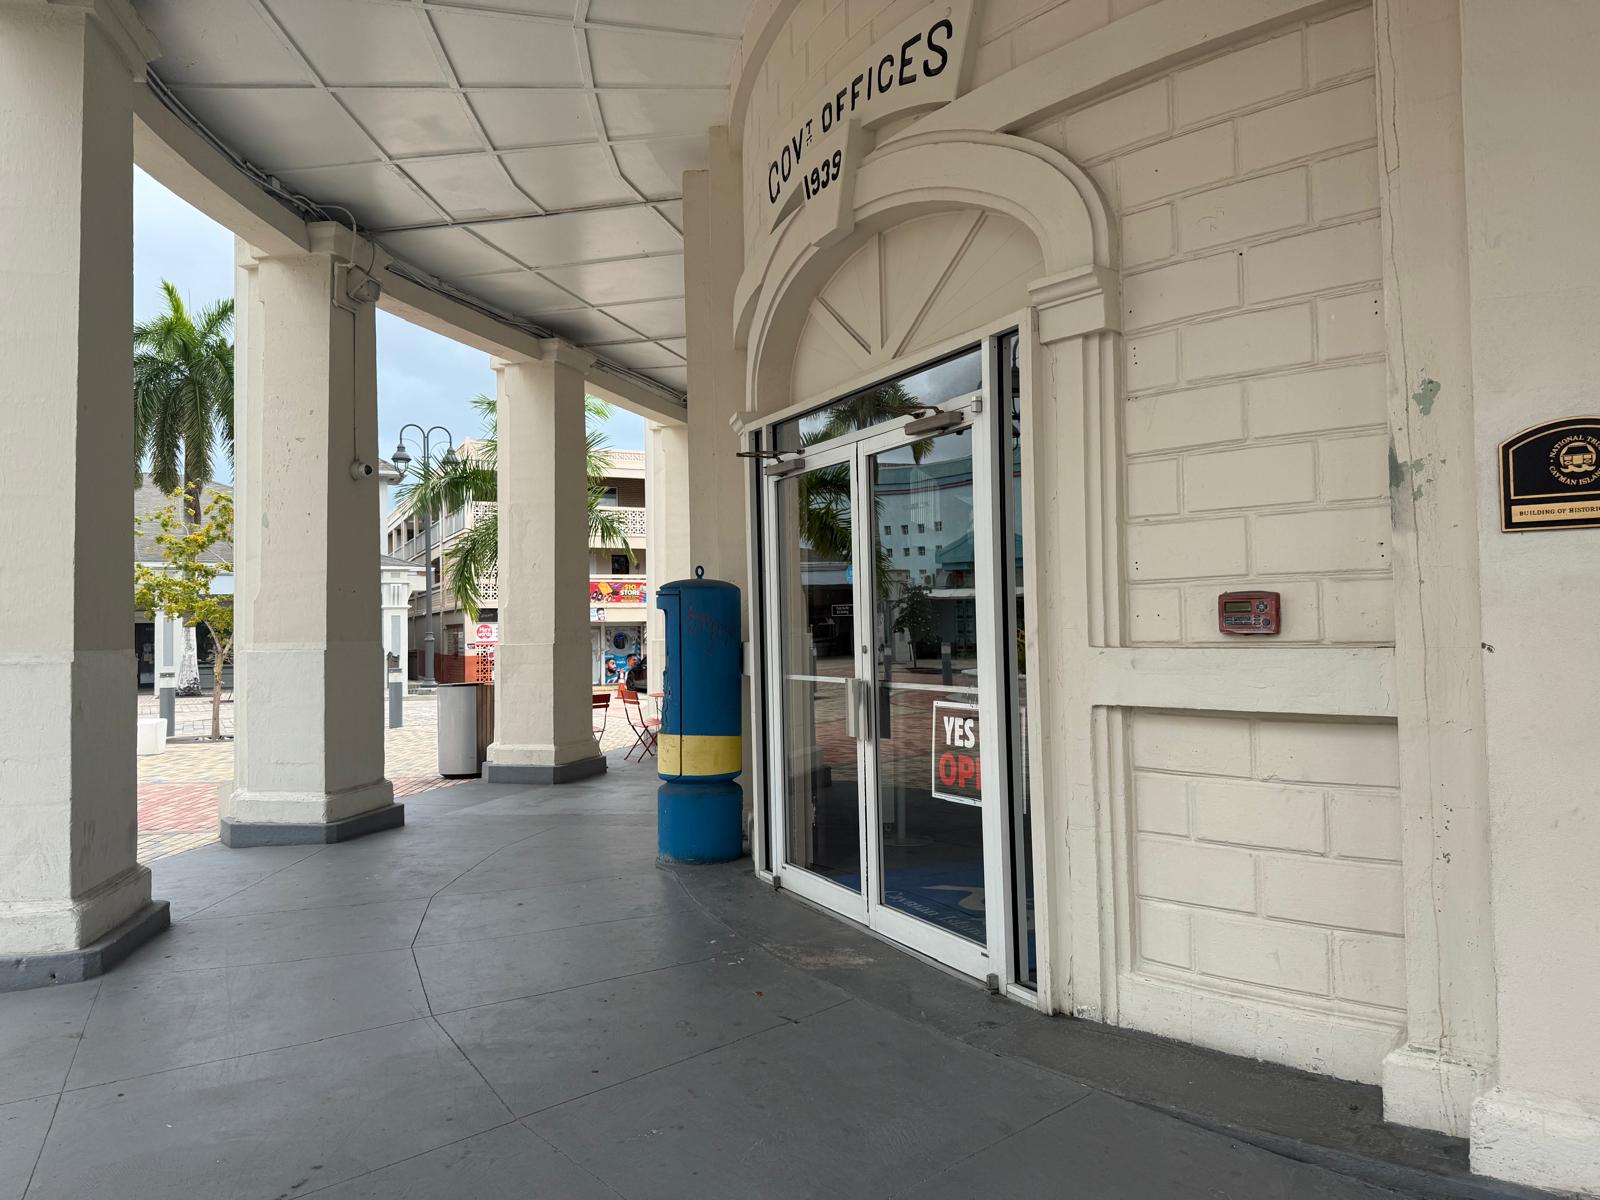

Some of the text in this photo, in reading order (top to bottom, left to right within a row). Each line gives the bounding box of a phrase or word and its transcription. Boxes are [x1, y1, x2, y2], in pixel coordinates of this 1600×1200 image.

[821, 18, 953, 133] OFFICES
[803, 149, 842, 200] 1939
[1549, 435, 1585, 458] NATIONAL
[1549, 466, 1577, 485] CAYMAN
[943, 716, 976, 748] YES
